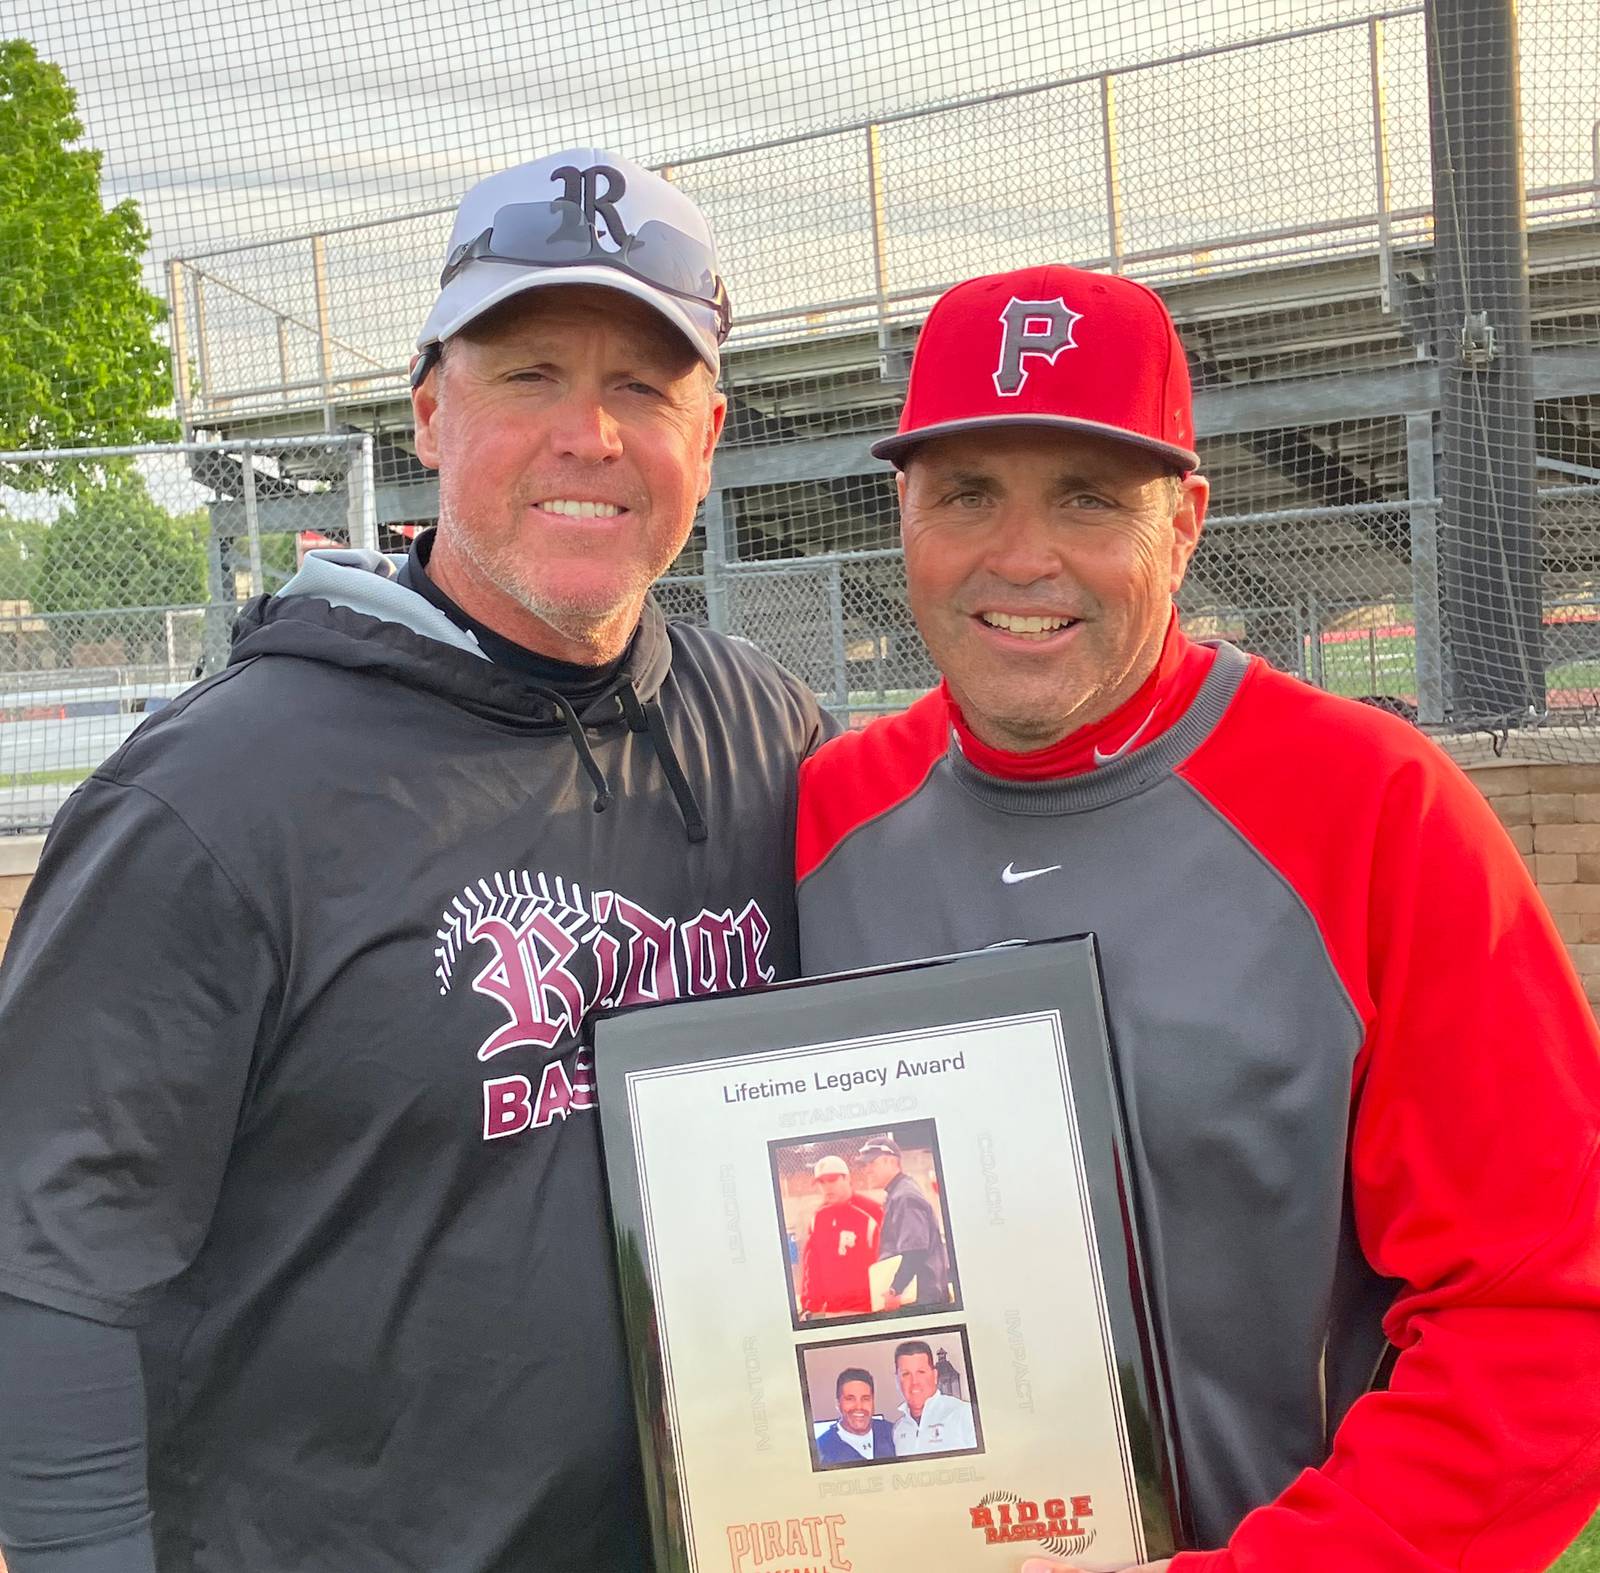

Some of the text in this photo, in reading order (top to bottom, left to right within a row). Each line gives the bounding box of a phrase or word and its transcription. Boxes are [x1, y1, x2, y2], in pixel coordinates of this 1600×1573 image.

[546, 165, 646, 250] R
[992, 296, 1085, 397] P
[723, 1051, 966, 1104] Lifetime Legacy Award
[779, 1096, 918, 1128] STANDARD
[720, 1161, 746, 1264] LEADER
[1003, 1309, 1034, 1414] IMPACT
[743, 1335, 771, 1452] MENTOR
[818, 1466, 985, 1498] ROLE MODEL
[969, 1495, 1094, 1529] RIDGE
[984, 1517, 1086, 1545] BASEBALL
[727, 1514, 852, 1573] PIRATE
